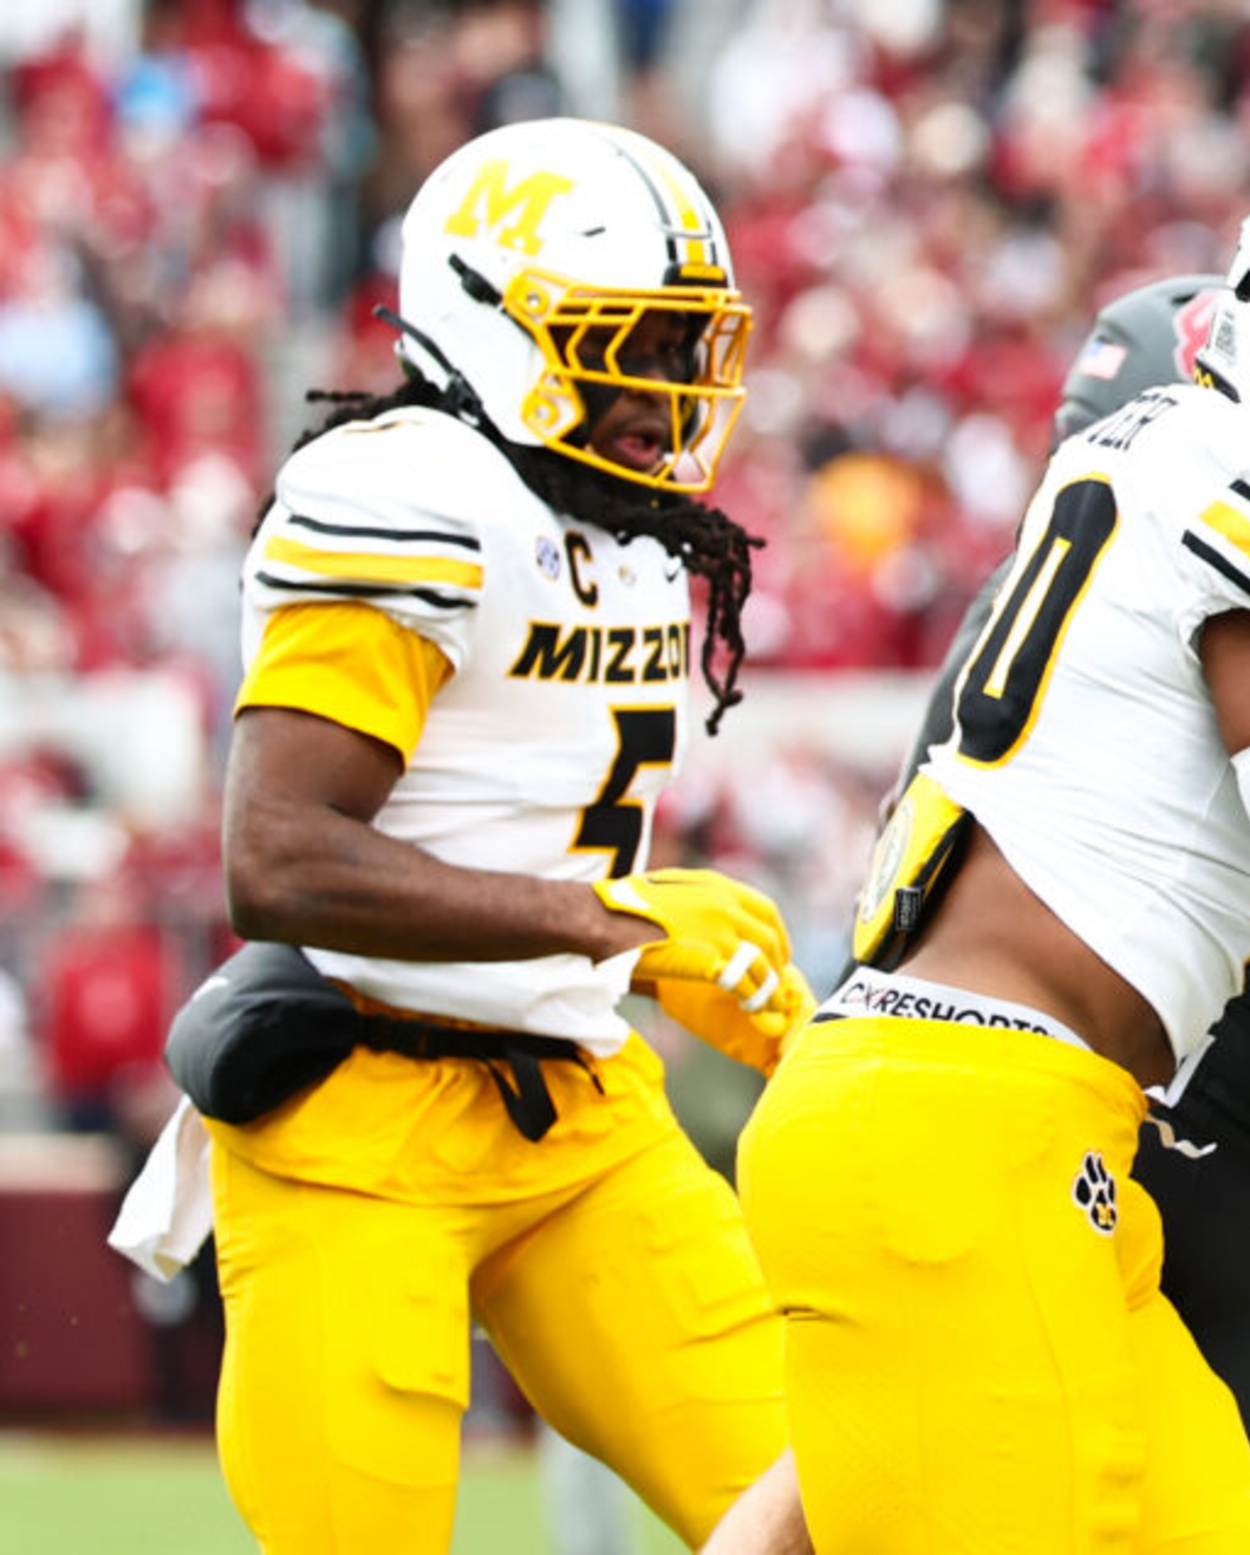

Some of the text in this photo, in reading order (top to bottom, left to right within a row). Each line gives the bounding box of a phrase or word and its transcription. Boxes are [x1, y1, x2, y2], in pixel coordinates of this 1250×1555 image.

[443, 159, 574, 257] M
[564, 530, 599, 610] C
[567, 703, 676, 880] 5
